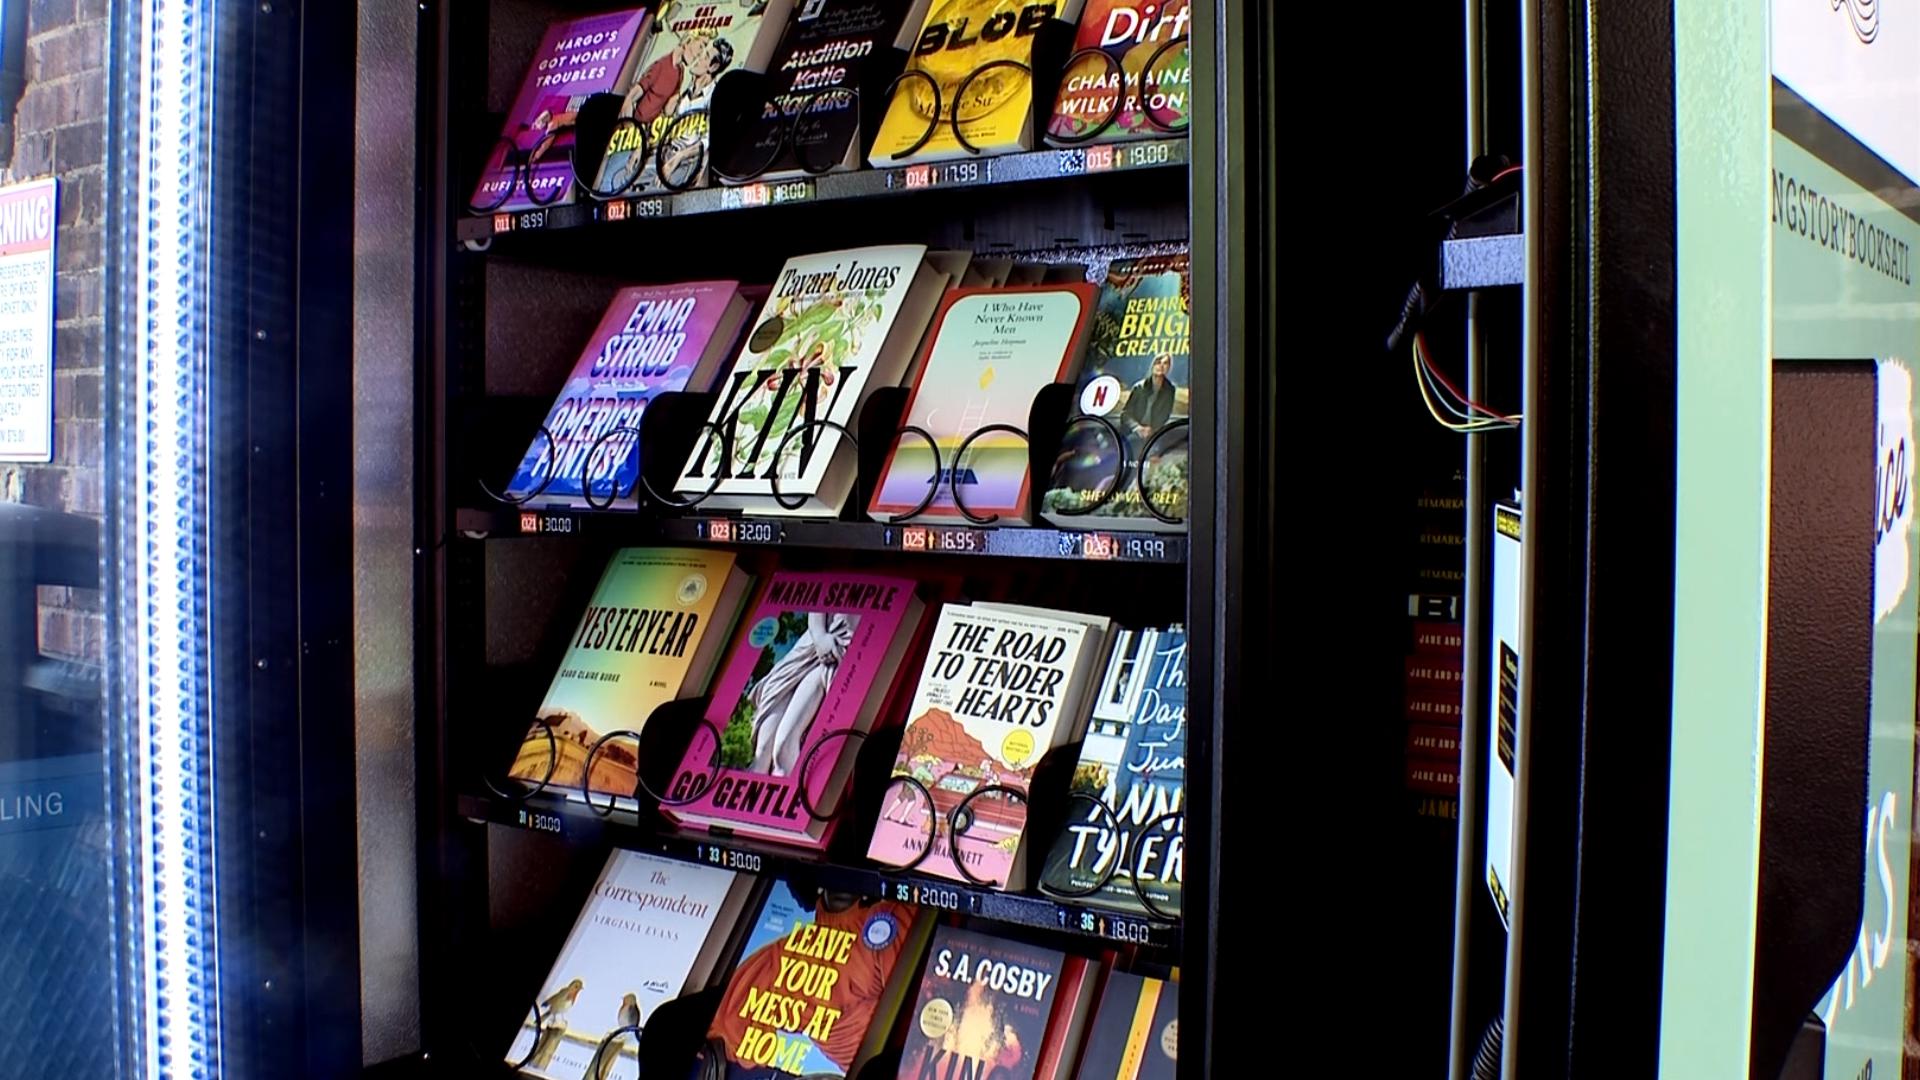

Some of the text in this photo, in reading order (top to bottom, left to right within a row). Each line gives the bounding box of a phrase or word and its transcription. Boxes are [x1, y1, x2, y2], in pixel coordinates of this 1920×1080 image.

[1100, 5, 1189, 47] Dirt
[555, 30, 618, 52] MARGO'S
[538, 47, 620, 71] GOT MONEY
[781, 40, 873, 71] Audition
[535, 66, 606, 88] TROUBLES
[790, 65, 847, 92] Katie
[973, 94, 993, 108] Su
[1086, 153, 1112, 169] 015
[906, 171, 929, 188] 014
[495, 217, 510, 232] 011
[608, 204, 625, 219] 012
[837, 261, 901, 291] Jones
[623, 297, 696, 334] EMMA
[974, 313, 1044, 324] Never Known
[983, 302, 1044, 313] I Who Have
[993, 325, 1017, 335] Men
[594, 332, 687, 370] STRAUB
[1092, 385, 1108, 407] N
[684, 366, 858, 480] KIN
[521, 517, 572, 533] 021 30.00
[710, 523, 771, 541] 023 32.00
[903, 531, 976, 550] 025 16.95
[1126, 539, 1165, 558] 19.99
[767, 581, 899, 612] MARIA SEMPLE
[575, 607, 699, 658] YESTERYEAR
[947, 622, 1067, 664] THE ROAD
[932, 651, 965, 680] TO
[967, 657, 1064, 698] TENDER
[1156, 641, 1187, 690] Th
[954, 687, 1055, 728] HEARTS
[0, 791, 63, 820] LING
[671, 770, 801, 820] GO GENTLE
[709, 846, 720, 862] 33
[729, 851, 761, 871] 30.00
[649, 871, 671, 886] The
[594, 880, 710, 919] Correspondent
[896, 884, 958, 910] 35 20.00
[594, 914, 679, 940] VIRGINIA EVANS
[1080, 912, 1149, 943] 36 18.00
[784, 921, 857, 965] LEAVE
[774, 956, 839, 1001] YOUR
[975, 958, 1052, 1002] COSBY
[739, 987, 842, 1042] MESS AT
[735, 1026, 812, 1077] HOME
